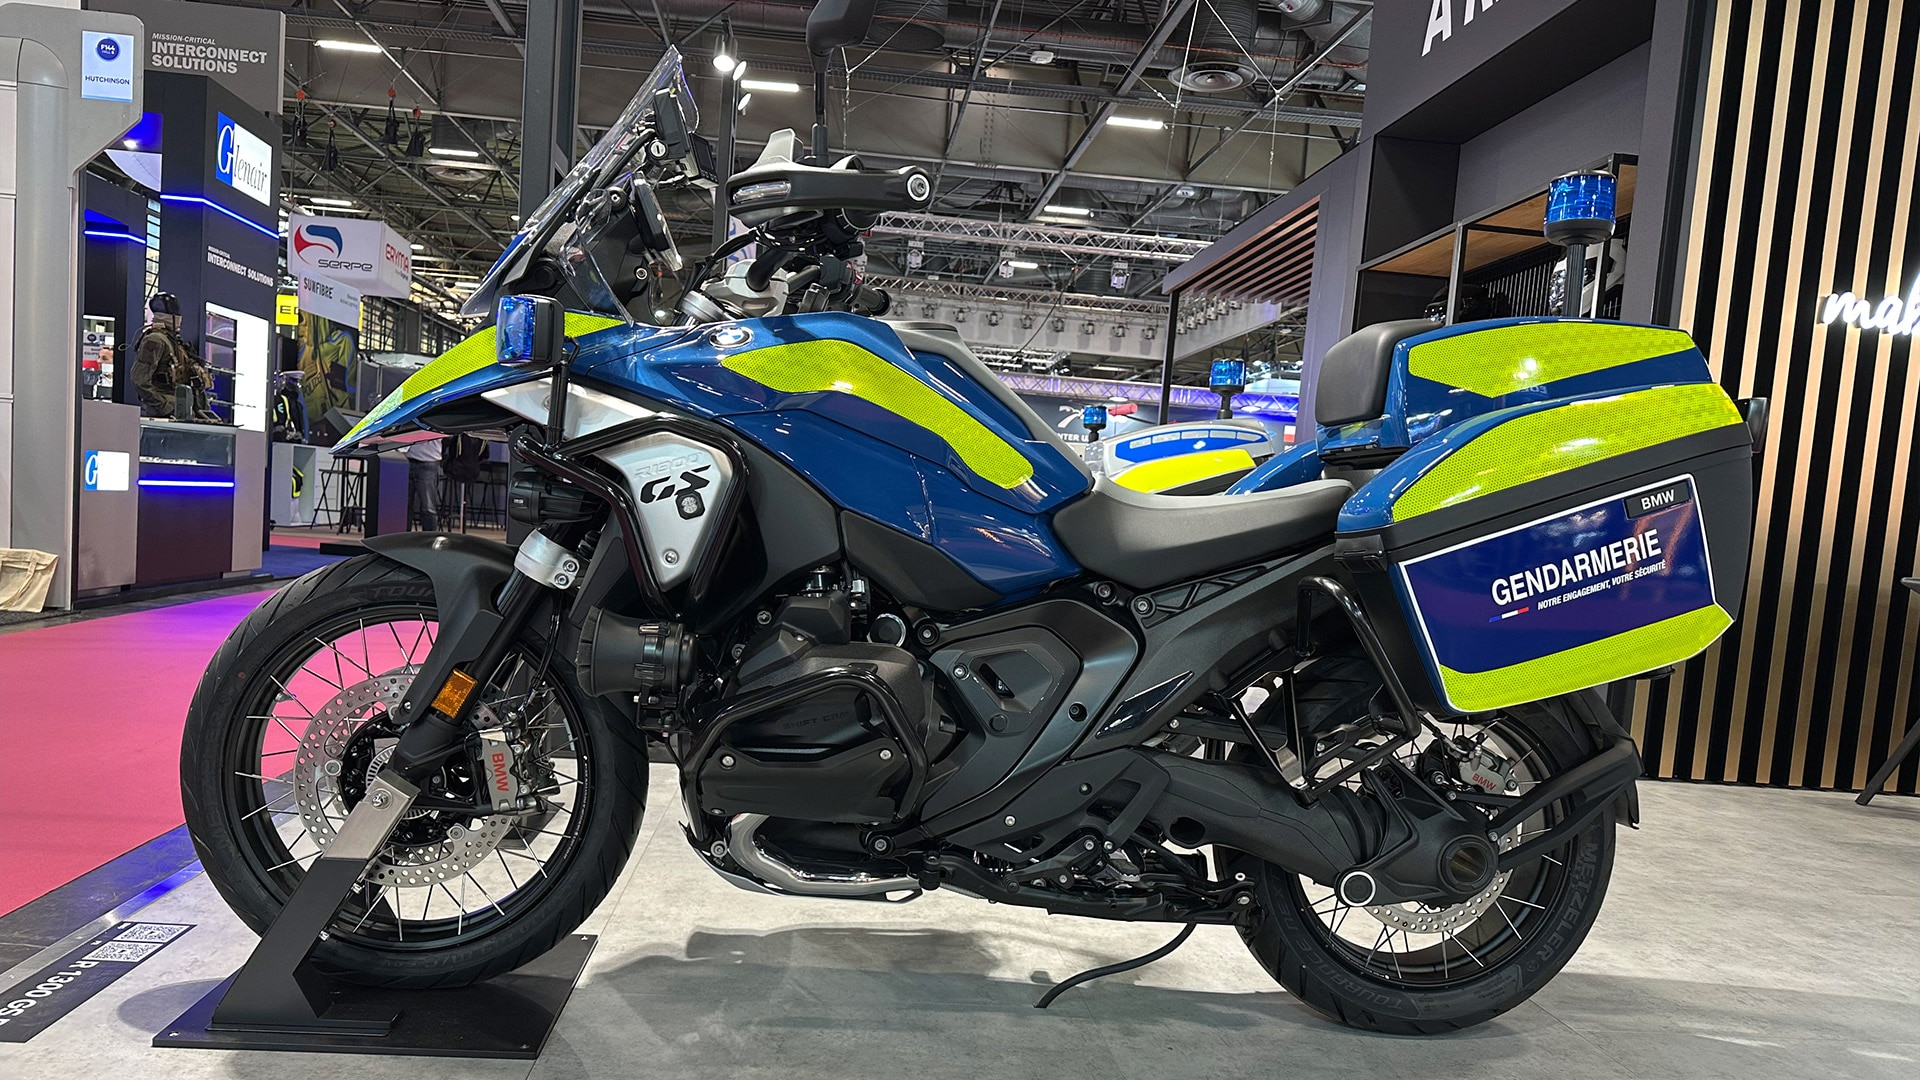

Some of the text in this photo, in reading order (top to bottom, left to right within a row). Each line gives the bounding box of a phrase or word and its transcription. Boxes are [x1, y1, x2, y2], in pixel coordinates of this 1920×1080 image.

[151, 41, 267, 64] INTERCONNECT
[152, 33, 216, 45] MISSION-CRITICAL
[85, 75, 130, 85] HUTCHINSON
[151, 54, 238, 74] SOLUTIONS
[217, 124, 268, 193] Glenair
[207, 251, 247, 277] INTERCONNECT
[247, 268, 274, 287] SOLUTIONS
[640, 464, 712, 504] GS
[1641, 489, 1675, 510] BMW
[1491, 528, 1662, 606] GENDARMERIE
[1537, 559, 1667, 610] NOTRE ENGAGEMENT, VOTRE SÉCURITÉ
[492, 753, 509, 792] BMW
[1472, 773, 1497, 791] BMW
[1536, 842, 1599, 961] METZELER
[68, 960, 101, 969] R
[1295, 939, 1404, 1010] TOURANCE
[24, 969, 83, 999] 1300
